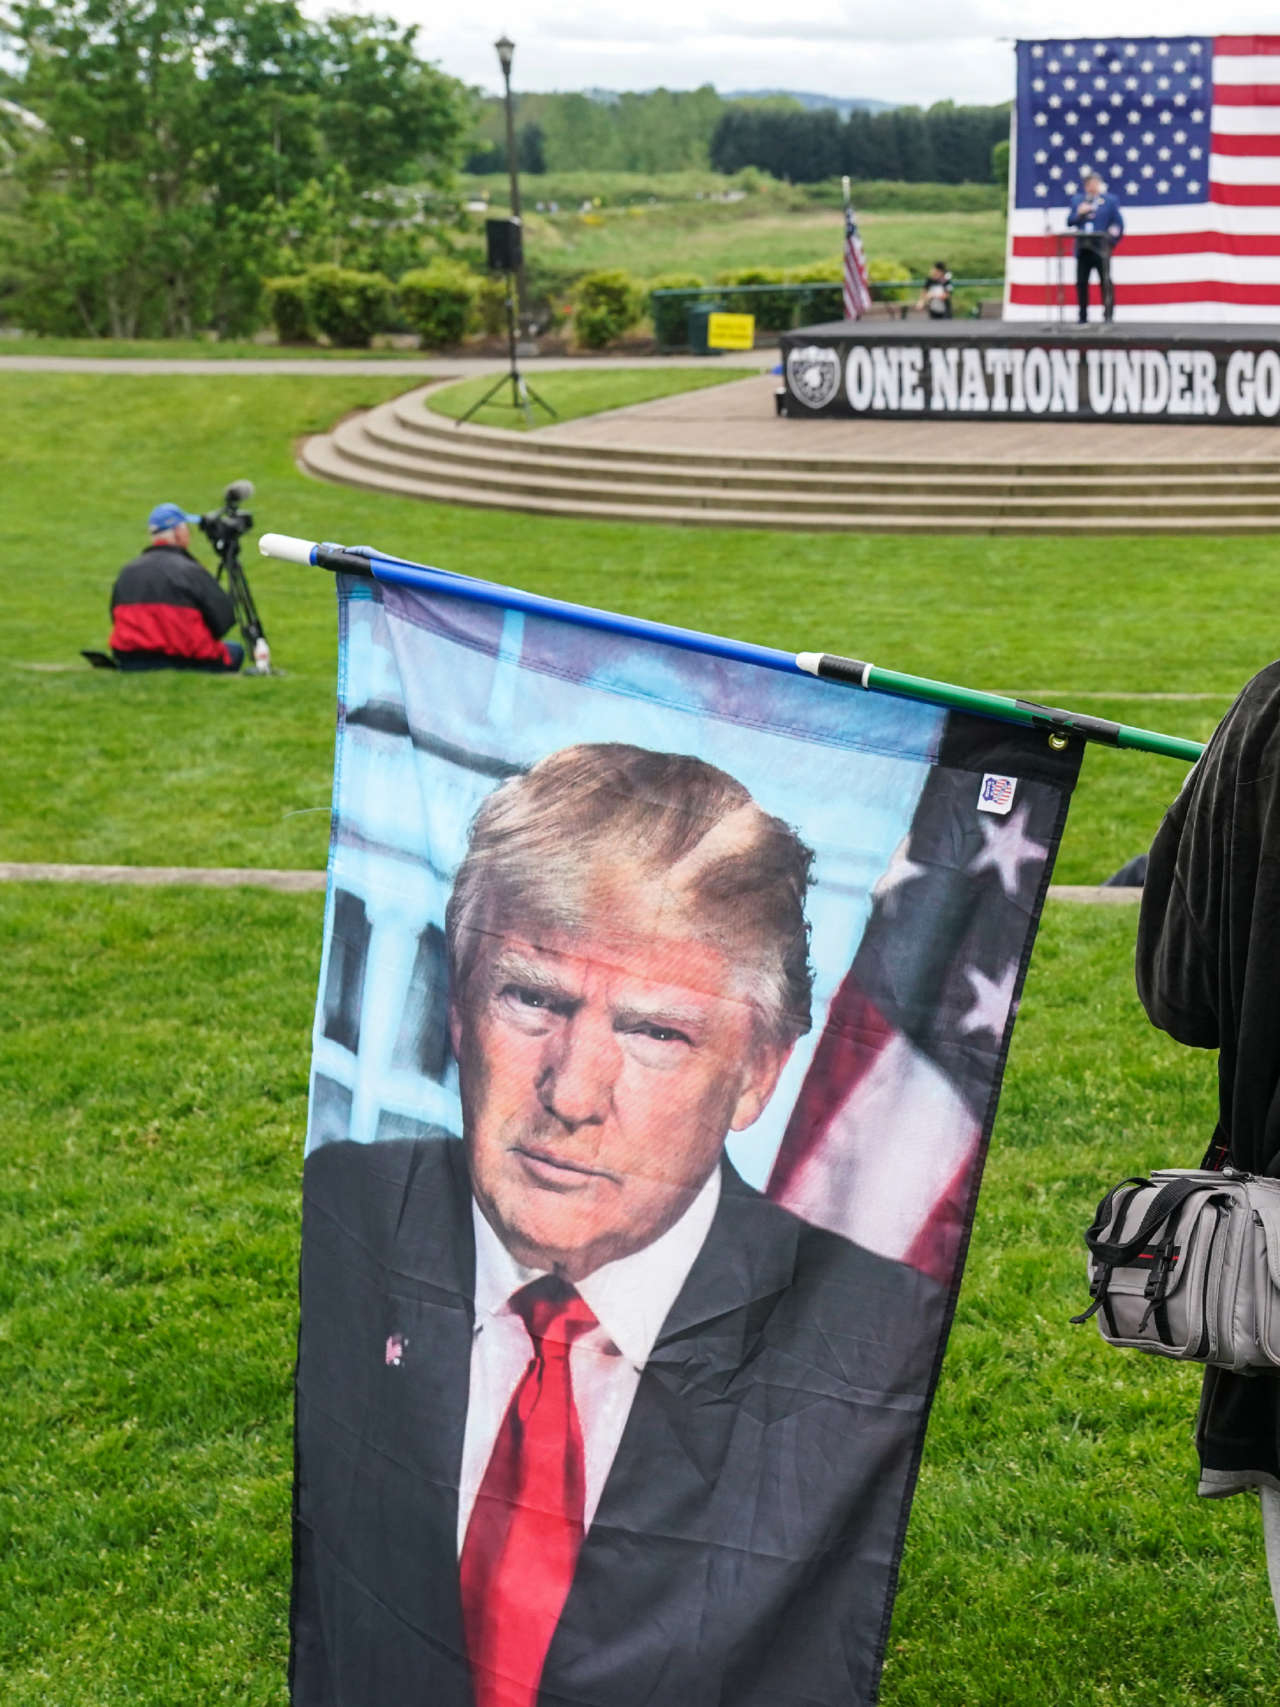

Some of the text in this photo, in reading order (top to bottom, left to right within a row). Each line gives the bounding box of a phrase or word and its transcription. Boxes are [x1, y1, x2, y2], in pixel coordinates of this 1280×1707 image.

[846, 346, 924, 411] ONE
[930, 347, 1079, 413] NATION
[1086, 349, 1220, 416] UNDER
